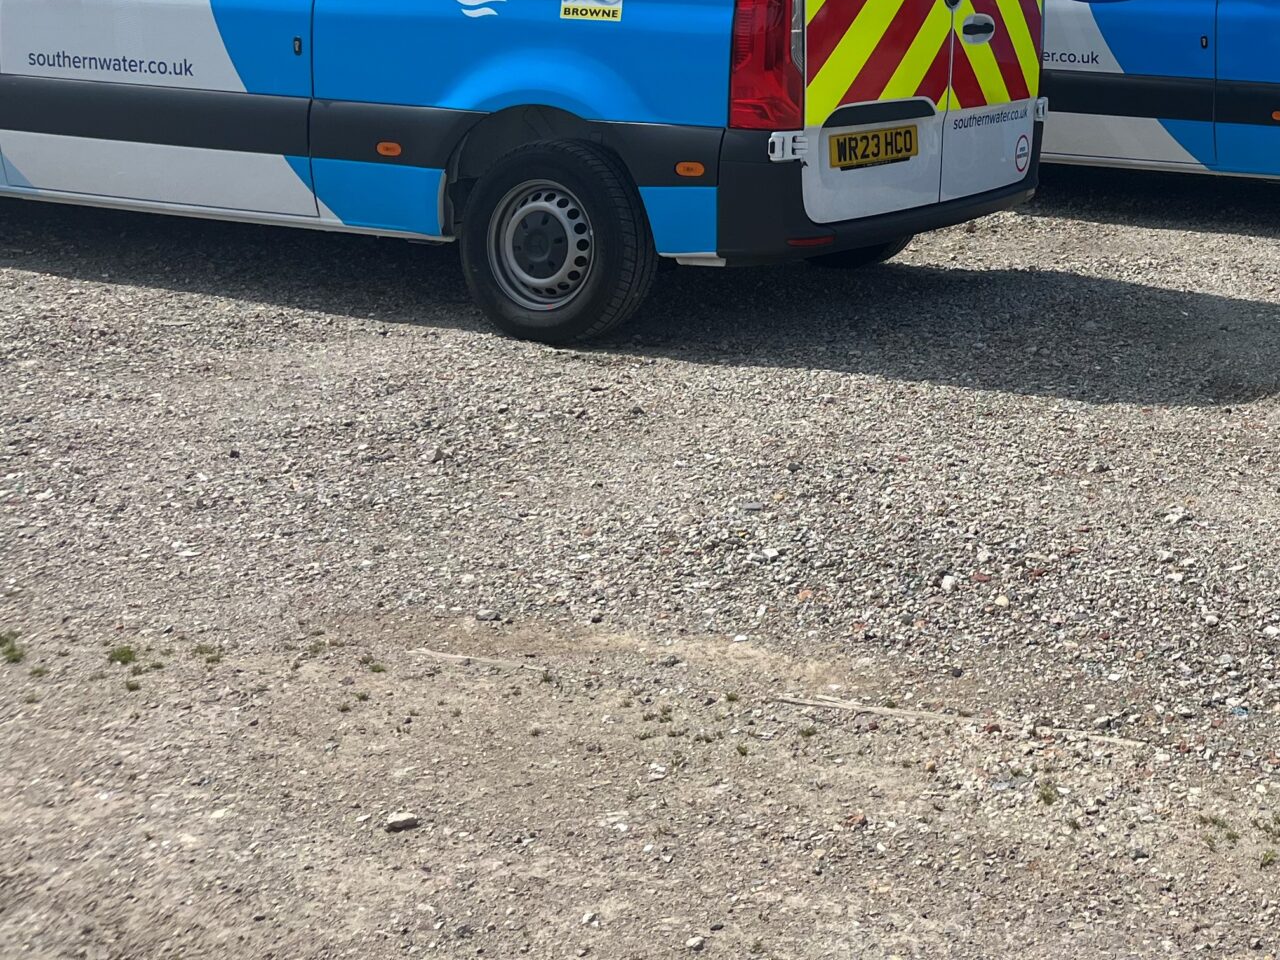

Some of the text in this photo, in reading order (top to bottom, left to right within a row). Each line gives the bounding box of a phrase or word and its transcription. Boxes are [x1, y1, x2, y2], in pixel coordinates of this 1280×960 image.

[563, 7, 618, 18] BROWNE
[28, 50, 194, 76] southernwater.co.uk
[953, 108, 1028, 130] southernwater.co.uk
[837, 129, 912, 163] WR23 HCO
